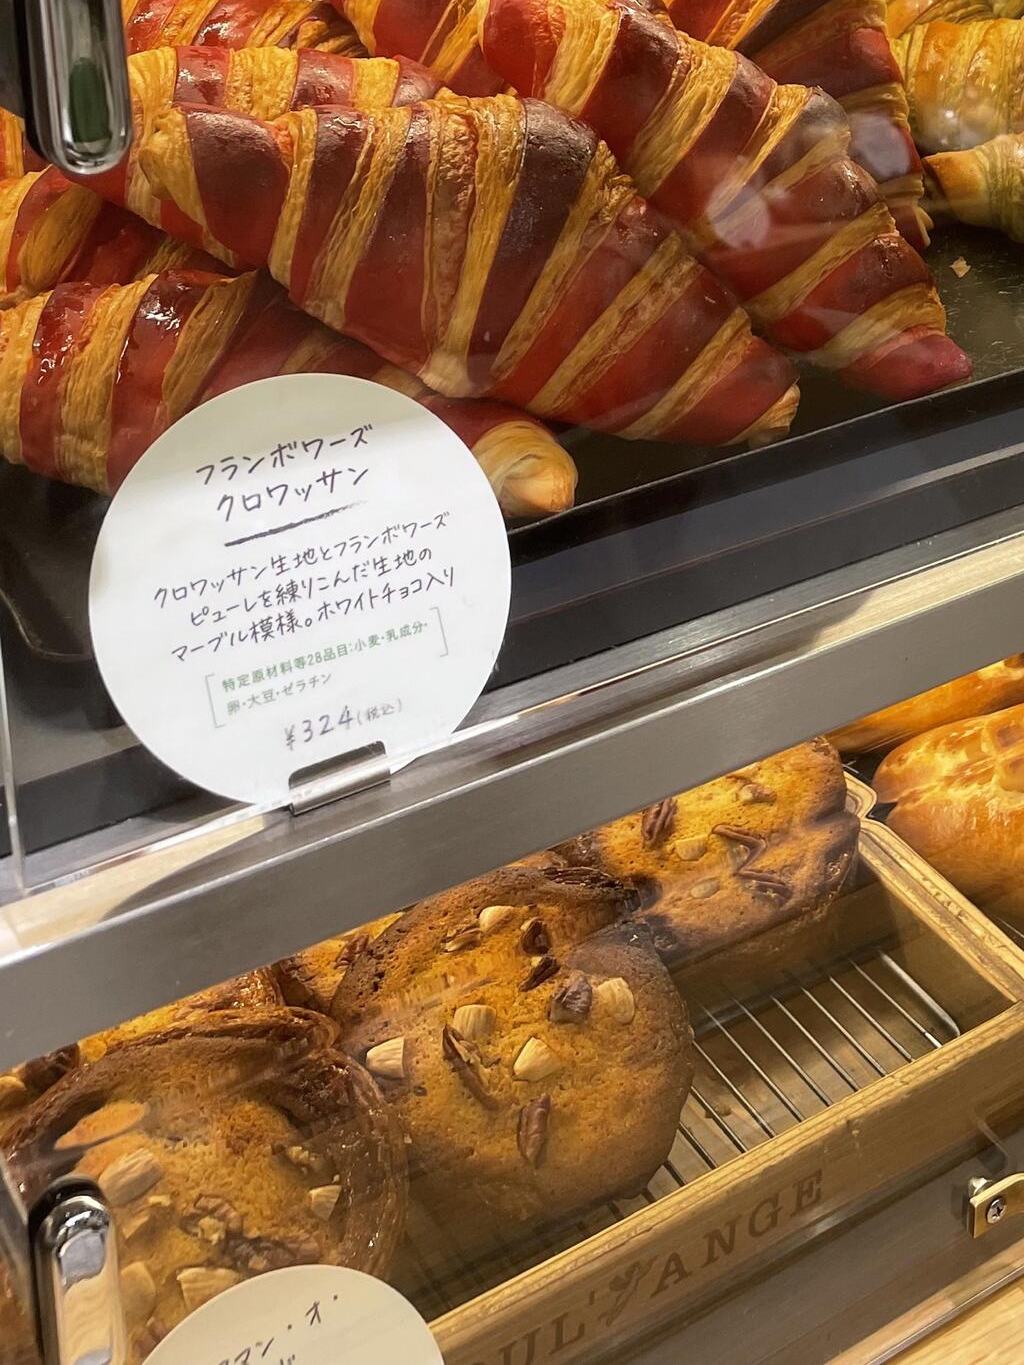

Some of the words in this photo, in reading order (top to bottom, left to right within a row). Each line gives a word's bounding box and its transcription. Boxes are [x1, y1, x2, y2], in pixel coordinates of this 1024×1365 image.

[195, 424, 375, 486] フランボワーズ
[216, 467, 370, 523] クロワッサン
